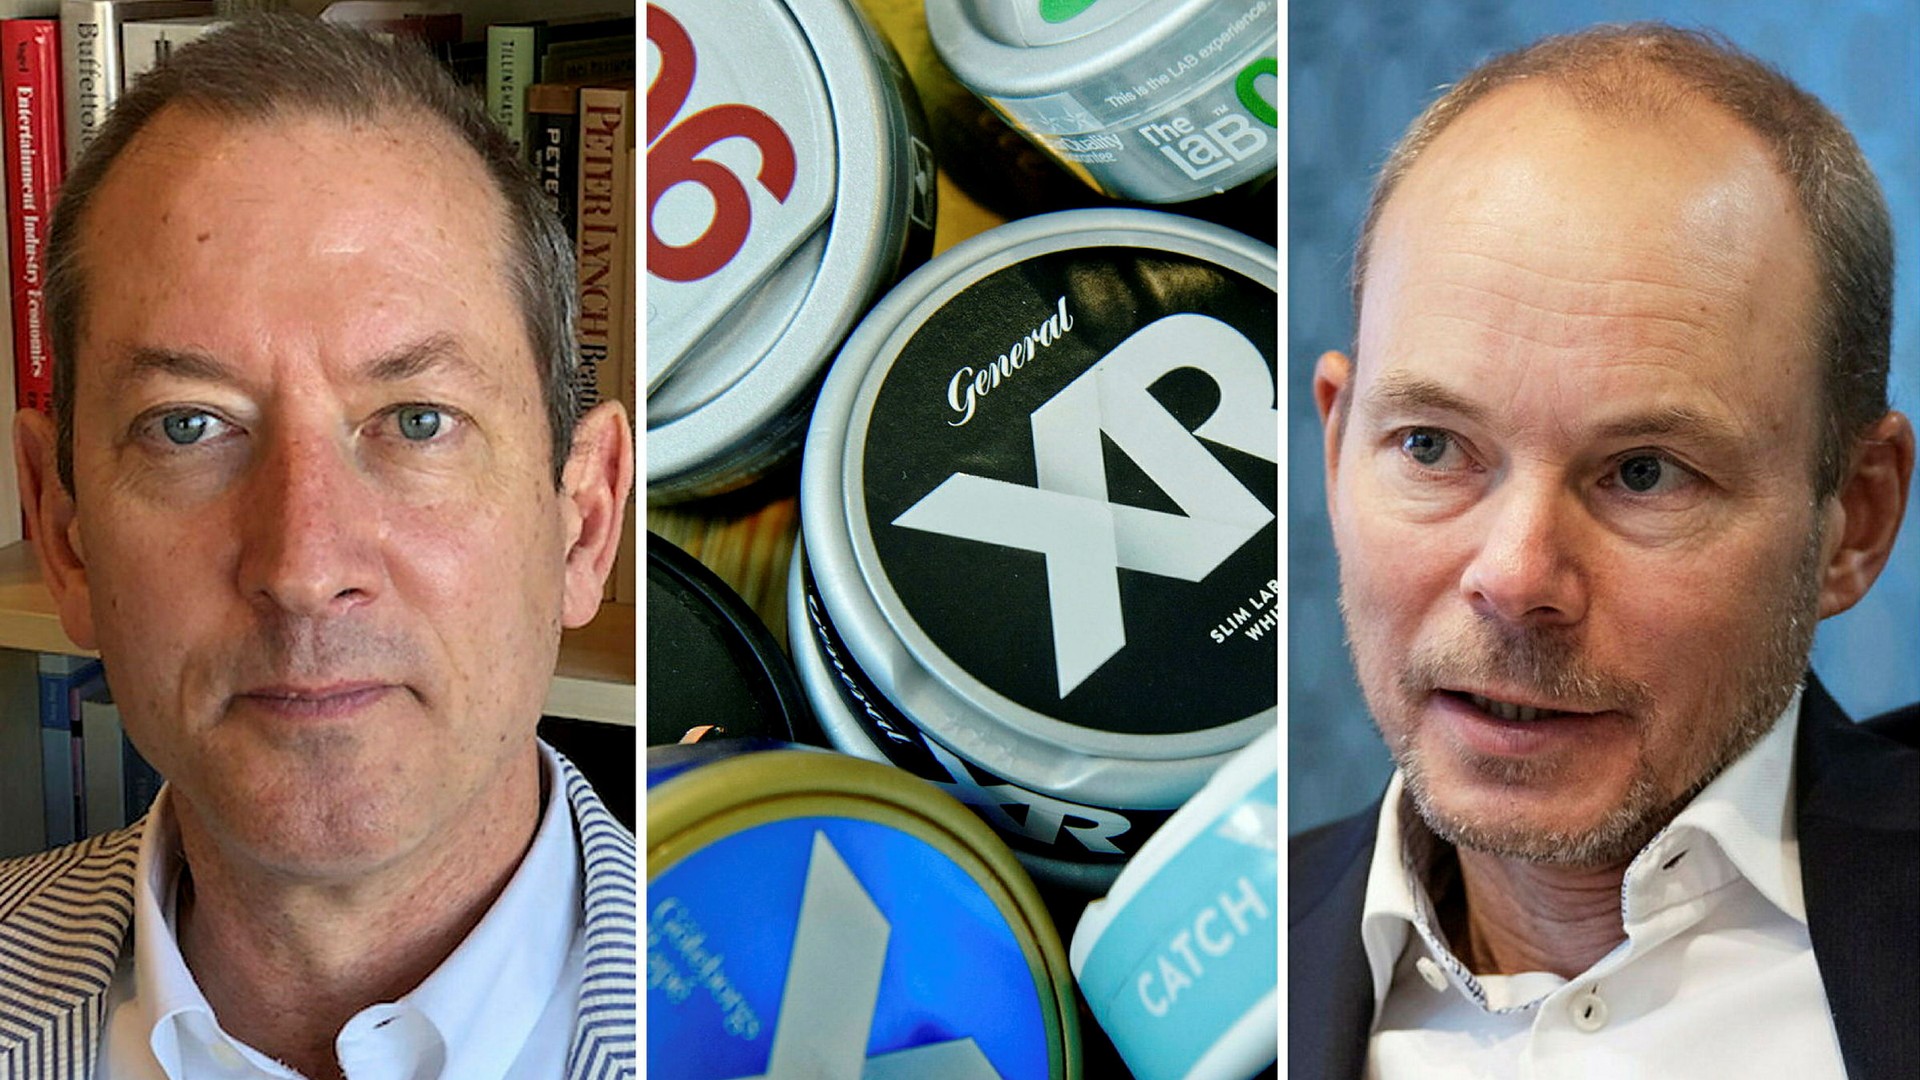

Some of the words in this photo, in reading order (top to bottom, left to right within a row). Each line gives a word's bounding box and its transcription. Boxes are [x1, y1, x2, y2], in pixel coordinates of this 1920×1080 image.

[1104, 91, 1136, 108] This
[1134, 84, 1149, 97] is
[1147, 73, 1170, 90] the
[1167, 53, 1199, 78] LAB
[1198, 1, 1272, 58] experience.
[16, 86, 37, 210] Entertainment
[584, 105, 622, 215] PETER
[1139, 116, 1195, 146] The
[23, 215, 41, 285] Industry
[580, 225, 618, 341] LYNCH
[28, 290, 47, 378] Economics
[947, 295, 1074, 427] General
[890, 312, 1277, 700] XR
[1210, 606, 1252, 644] SLIM
[1244, 604, 1277, 641] WHI
[1137, 876, 1270, 1017] CATCH
